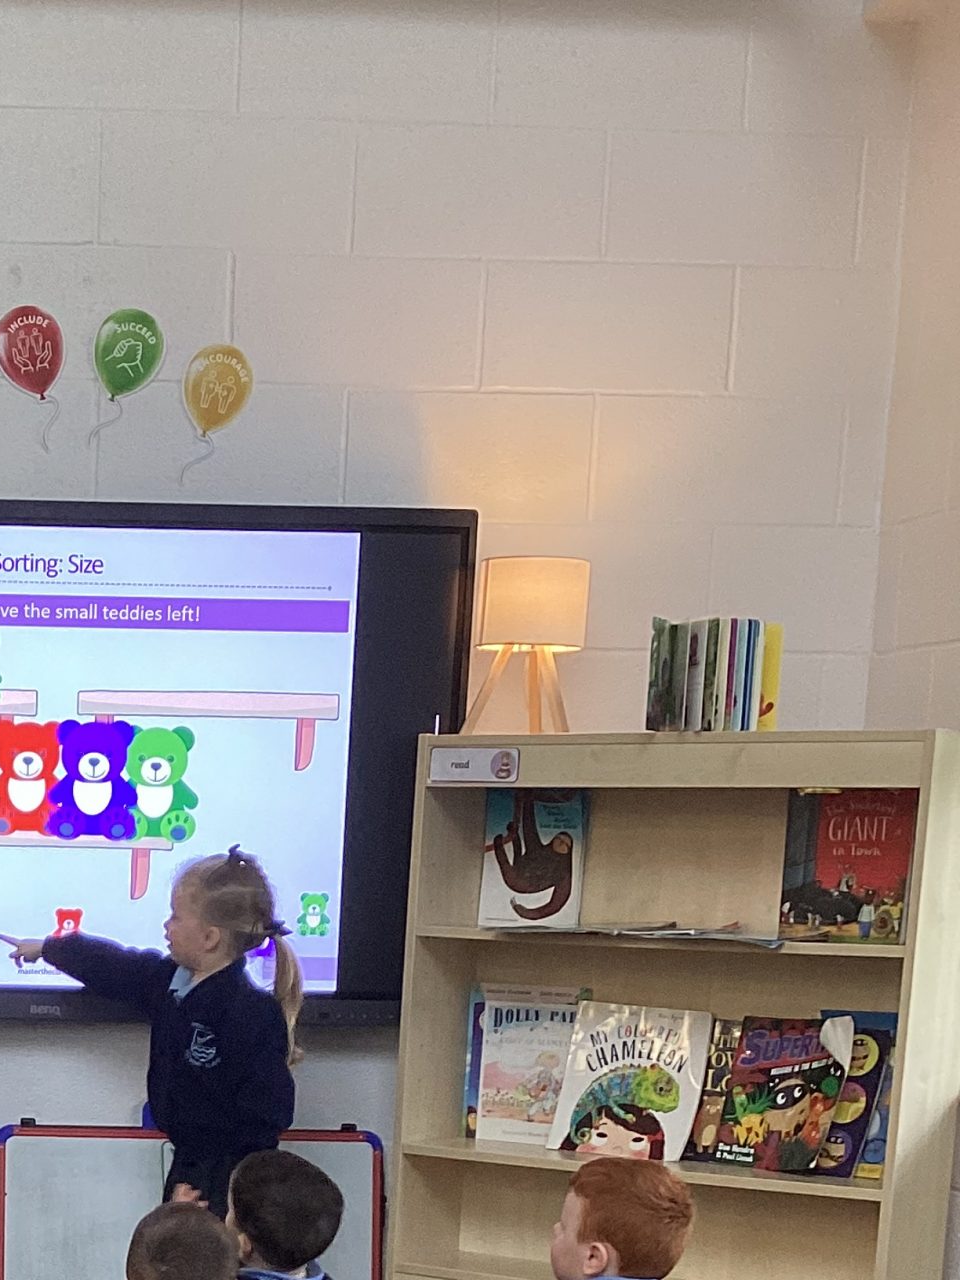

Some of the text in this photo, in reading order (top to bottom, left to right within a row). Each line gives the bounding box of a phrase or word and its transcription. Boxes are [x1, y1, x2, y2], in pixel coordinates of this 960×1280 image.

[7, 315, 50, 334] INCLUDE
[116, 322, 156, 344] SUCCEED
[68, 554, 104, 574] Size
[24, 603, 50, 618] the
[55, 604, 98, 620] small
[102, 605, 162, 621] teddies
[167, 606, 200, 622] left!
[450, 760, 470, 769] read
[829, 816, 893, 841] GIANT
[850, 843, 882, 856] Town
[494, 1007, 540, 1028] DOLLY
[590, 1030, 608, 1047] MY
[585, 1039, 689, 1073] CHAMELEON
